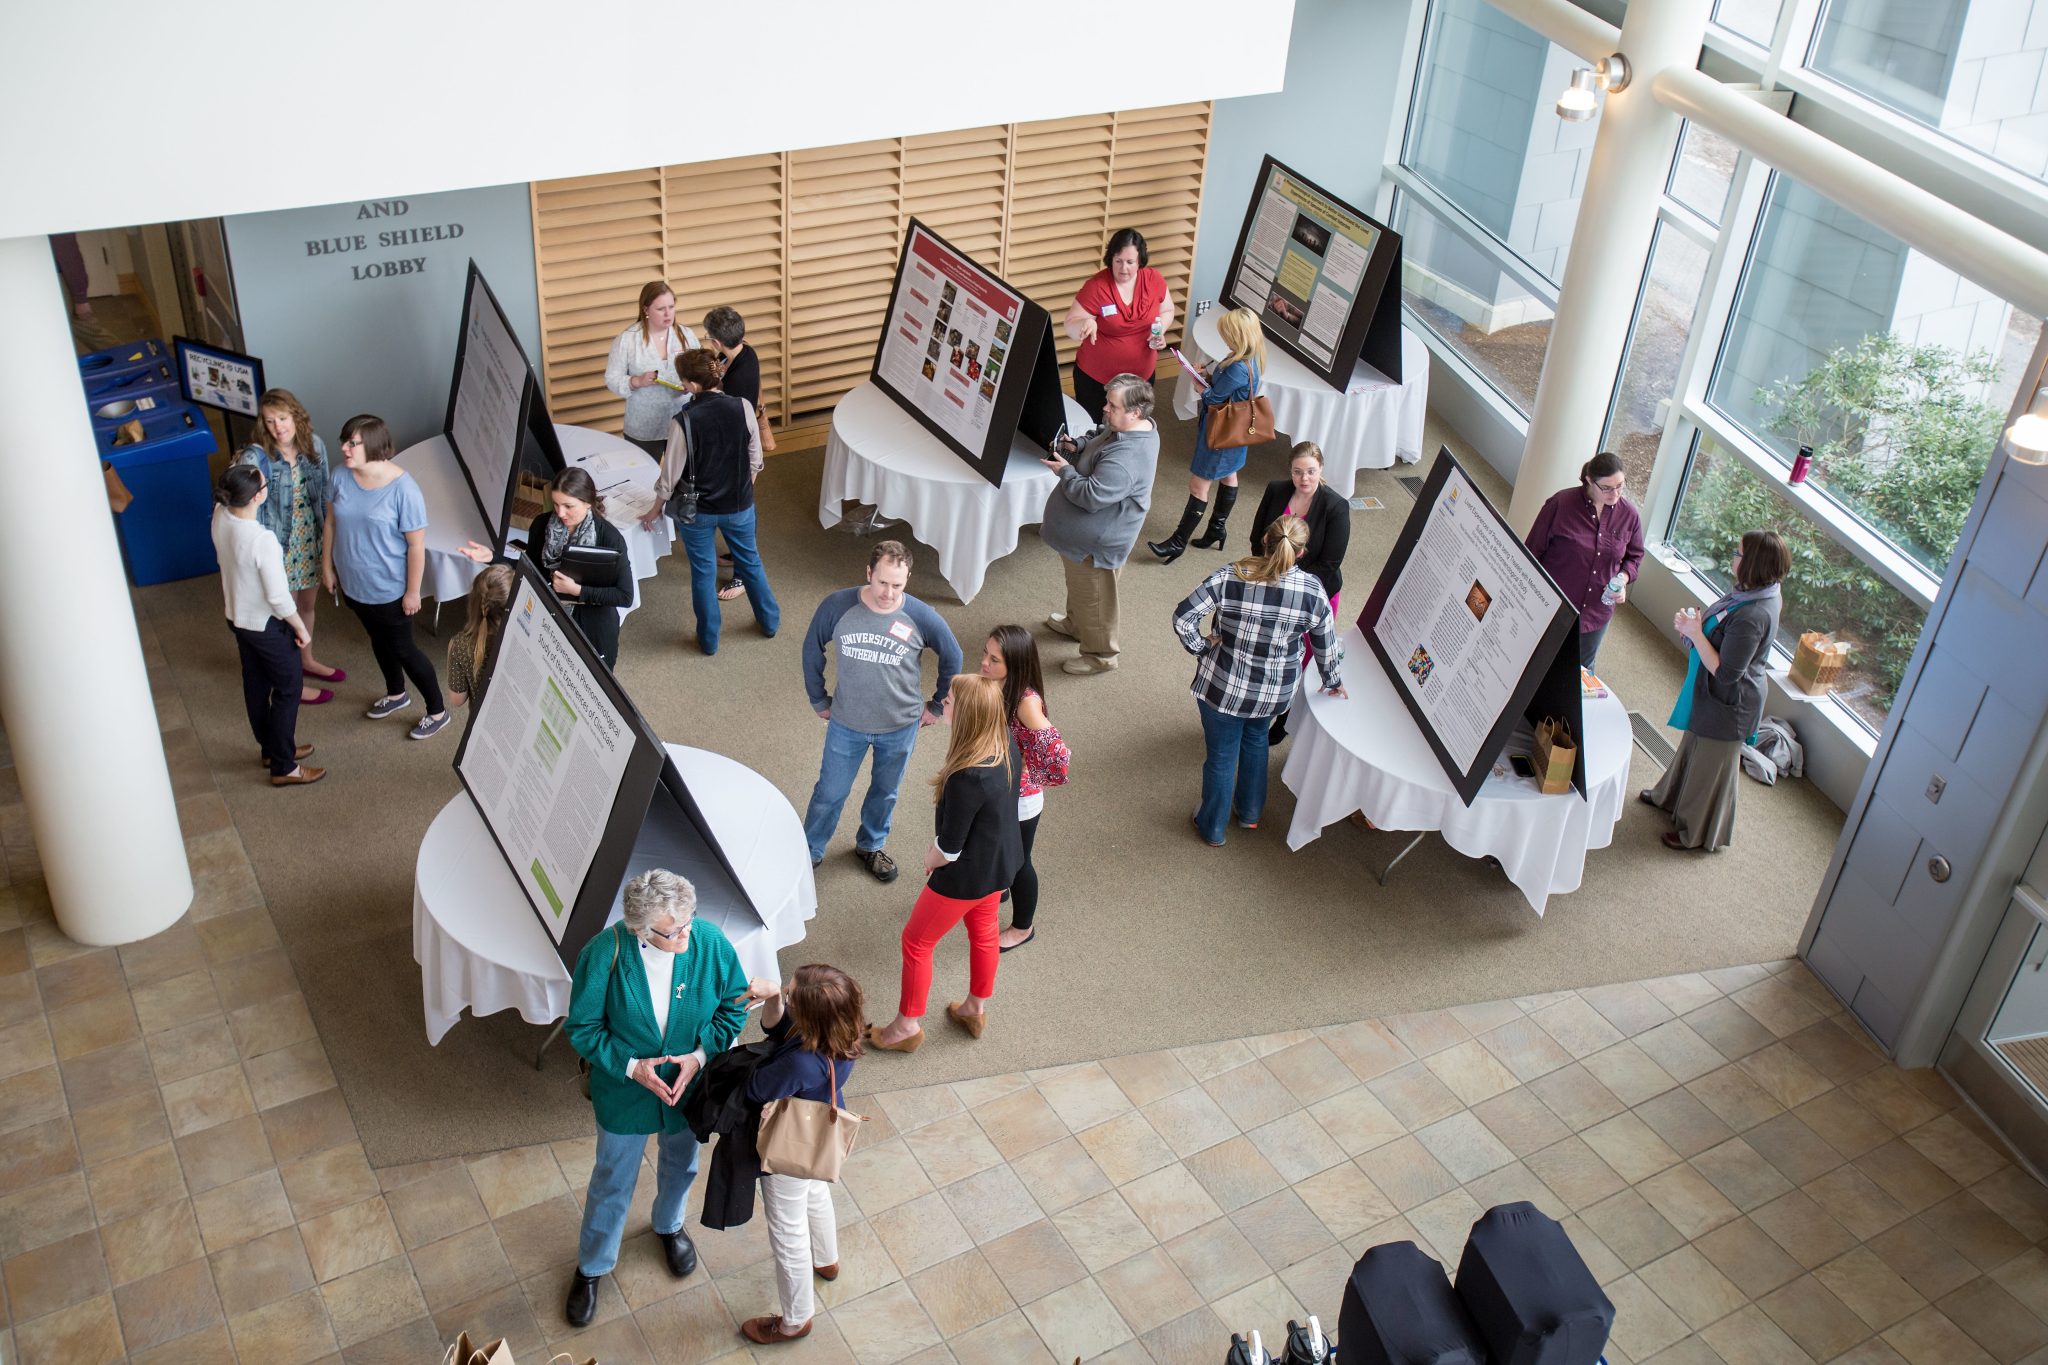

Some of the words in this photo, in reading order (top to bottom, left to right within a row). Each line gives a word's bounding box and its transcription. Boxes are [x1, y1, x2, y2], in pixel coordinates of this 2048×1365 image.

[357, 200, 409, 220] AND
[305, 235, 367, 256] BLUE
[379, 223, 464, 247] SHIELD
[352, 257, 426, 280] LOBBY
[189, 353, 225, 369] RECYCLING
[840, 632, 897, 650] UNIVERSITY
[896, 644, 909, 655] OF
[841, 645, 878, 662] SOUTHERN
[878, 652, 903, 666] MAINE
[538, 633, 551, 657] Study
[555, 659, 563, 675] the
[563, 670, 589, 713] Experiences
[593, 716, 615, 752] Clinicians
[580, 673, 621, 738] Phenomenological
